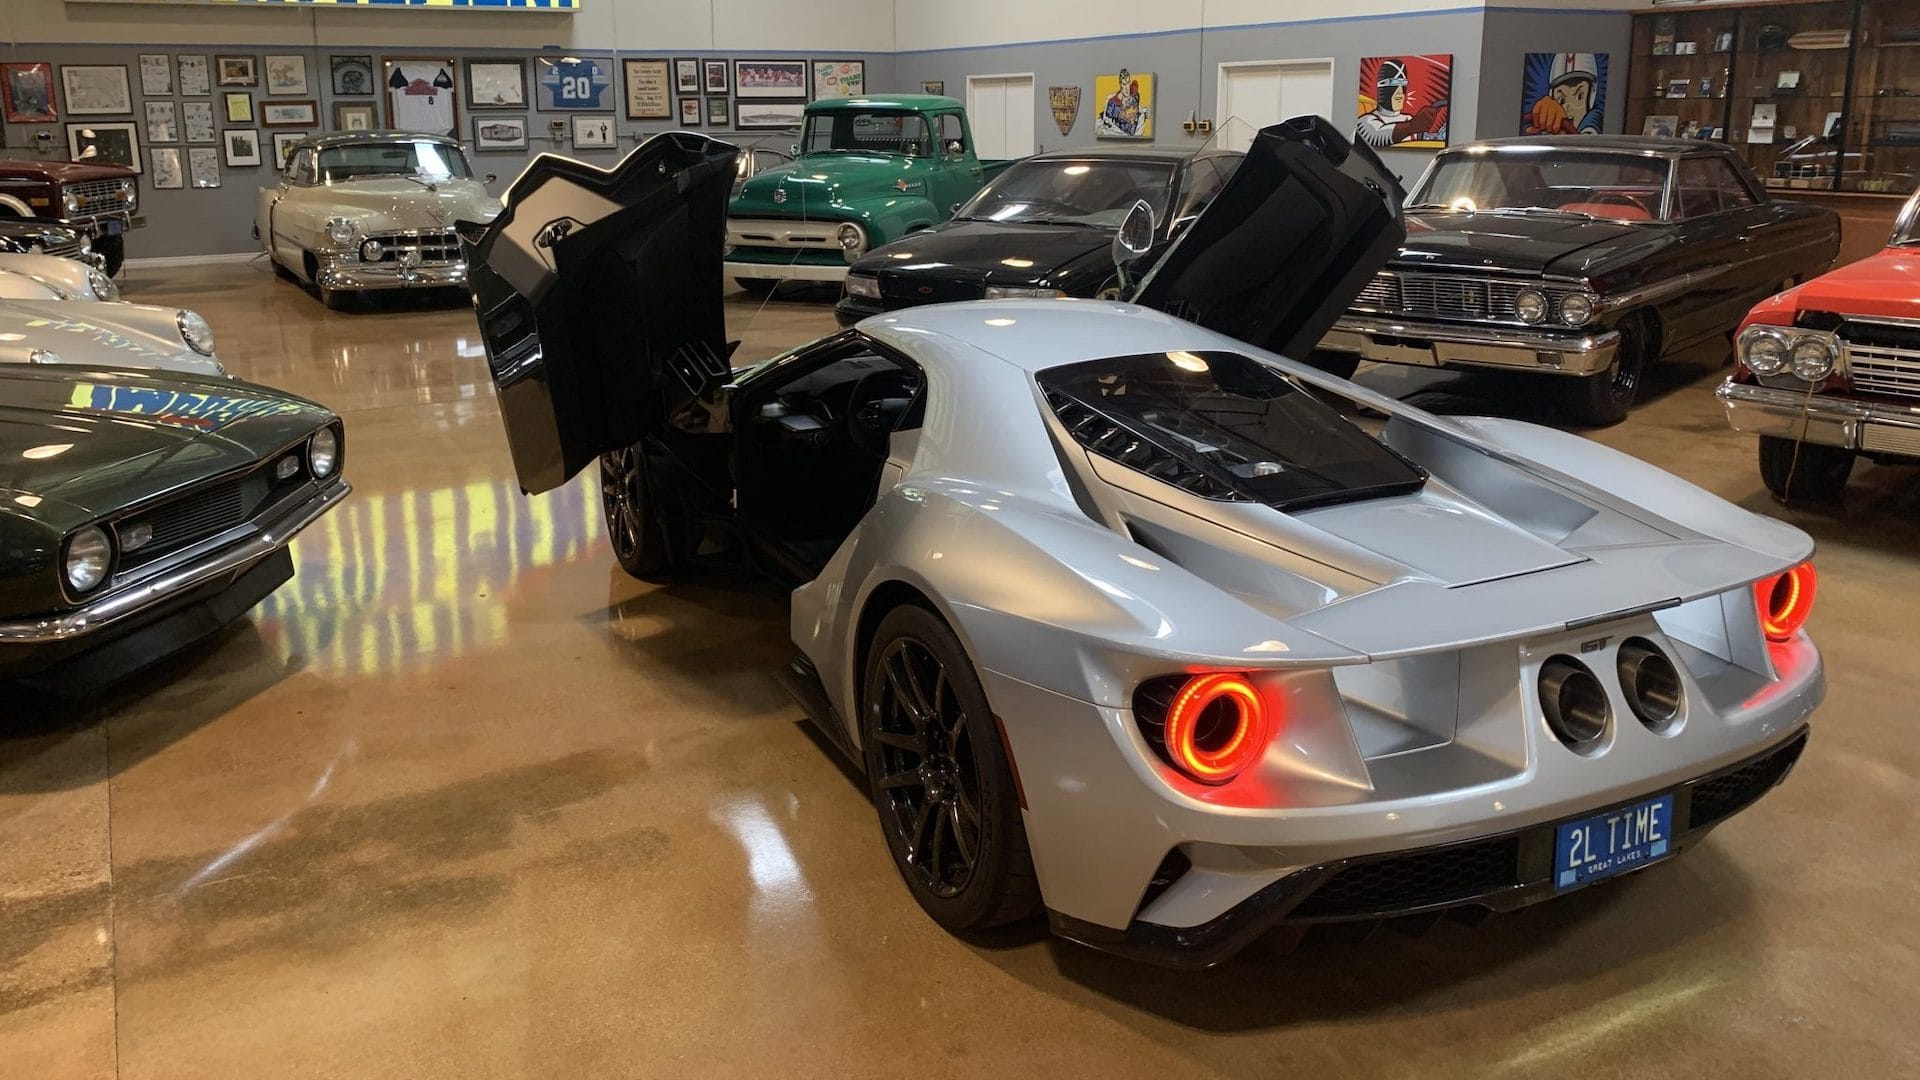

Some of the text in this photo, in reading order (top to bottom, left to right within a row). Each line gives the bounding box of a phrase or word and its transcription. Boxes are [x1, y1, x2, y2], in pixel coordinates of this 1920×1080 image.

[562, 76, 590, 99] 20
[1569, 803, 1663, 868] 2L TIME
[1588, 850, 1641, 874] GREAT LAKES
